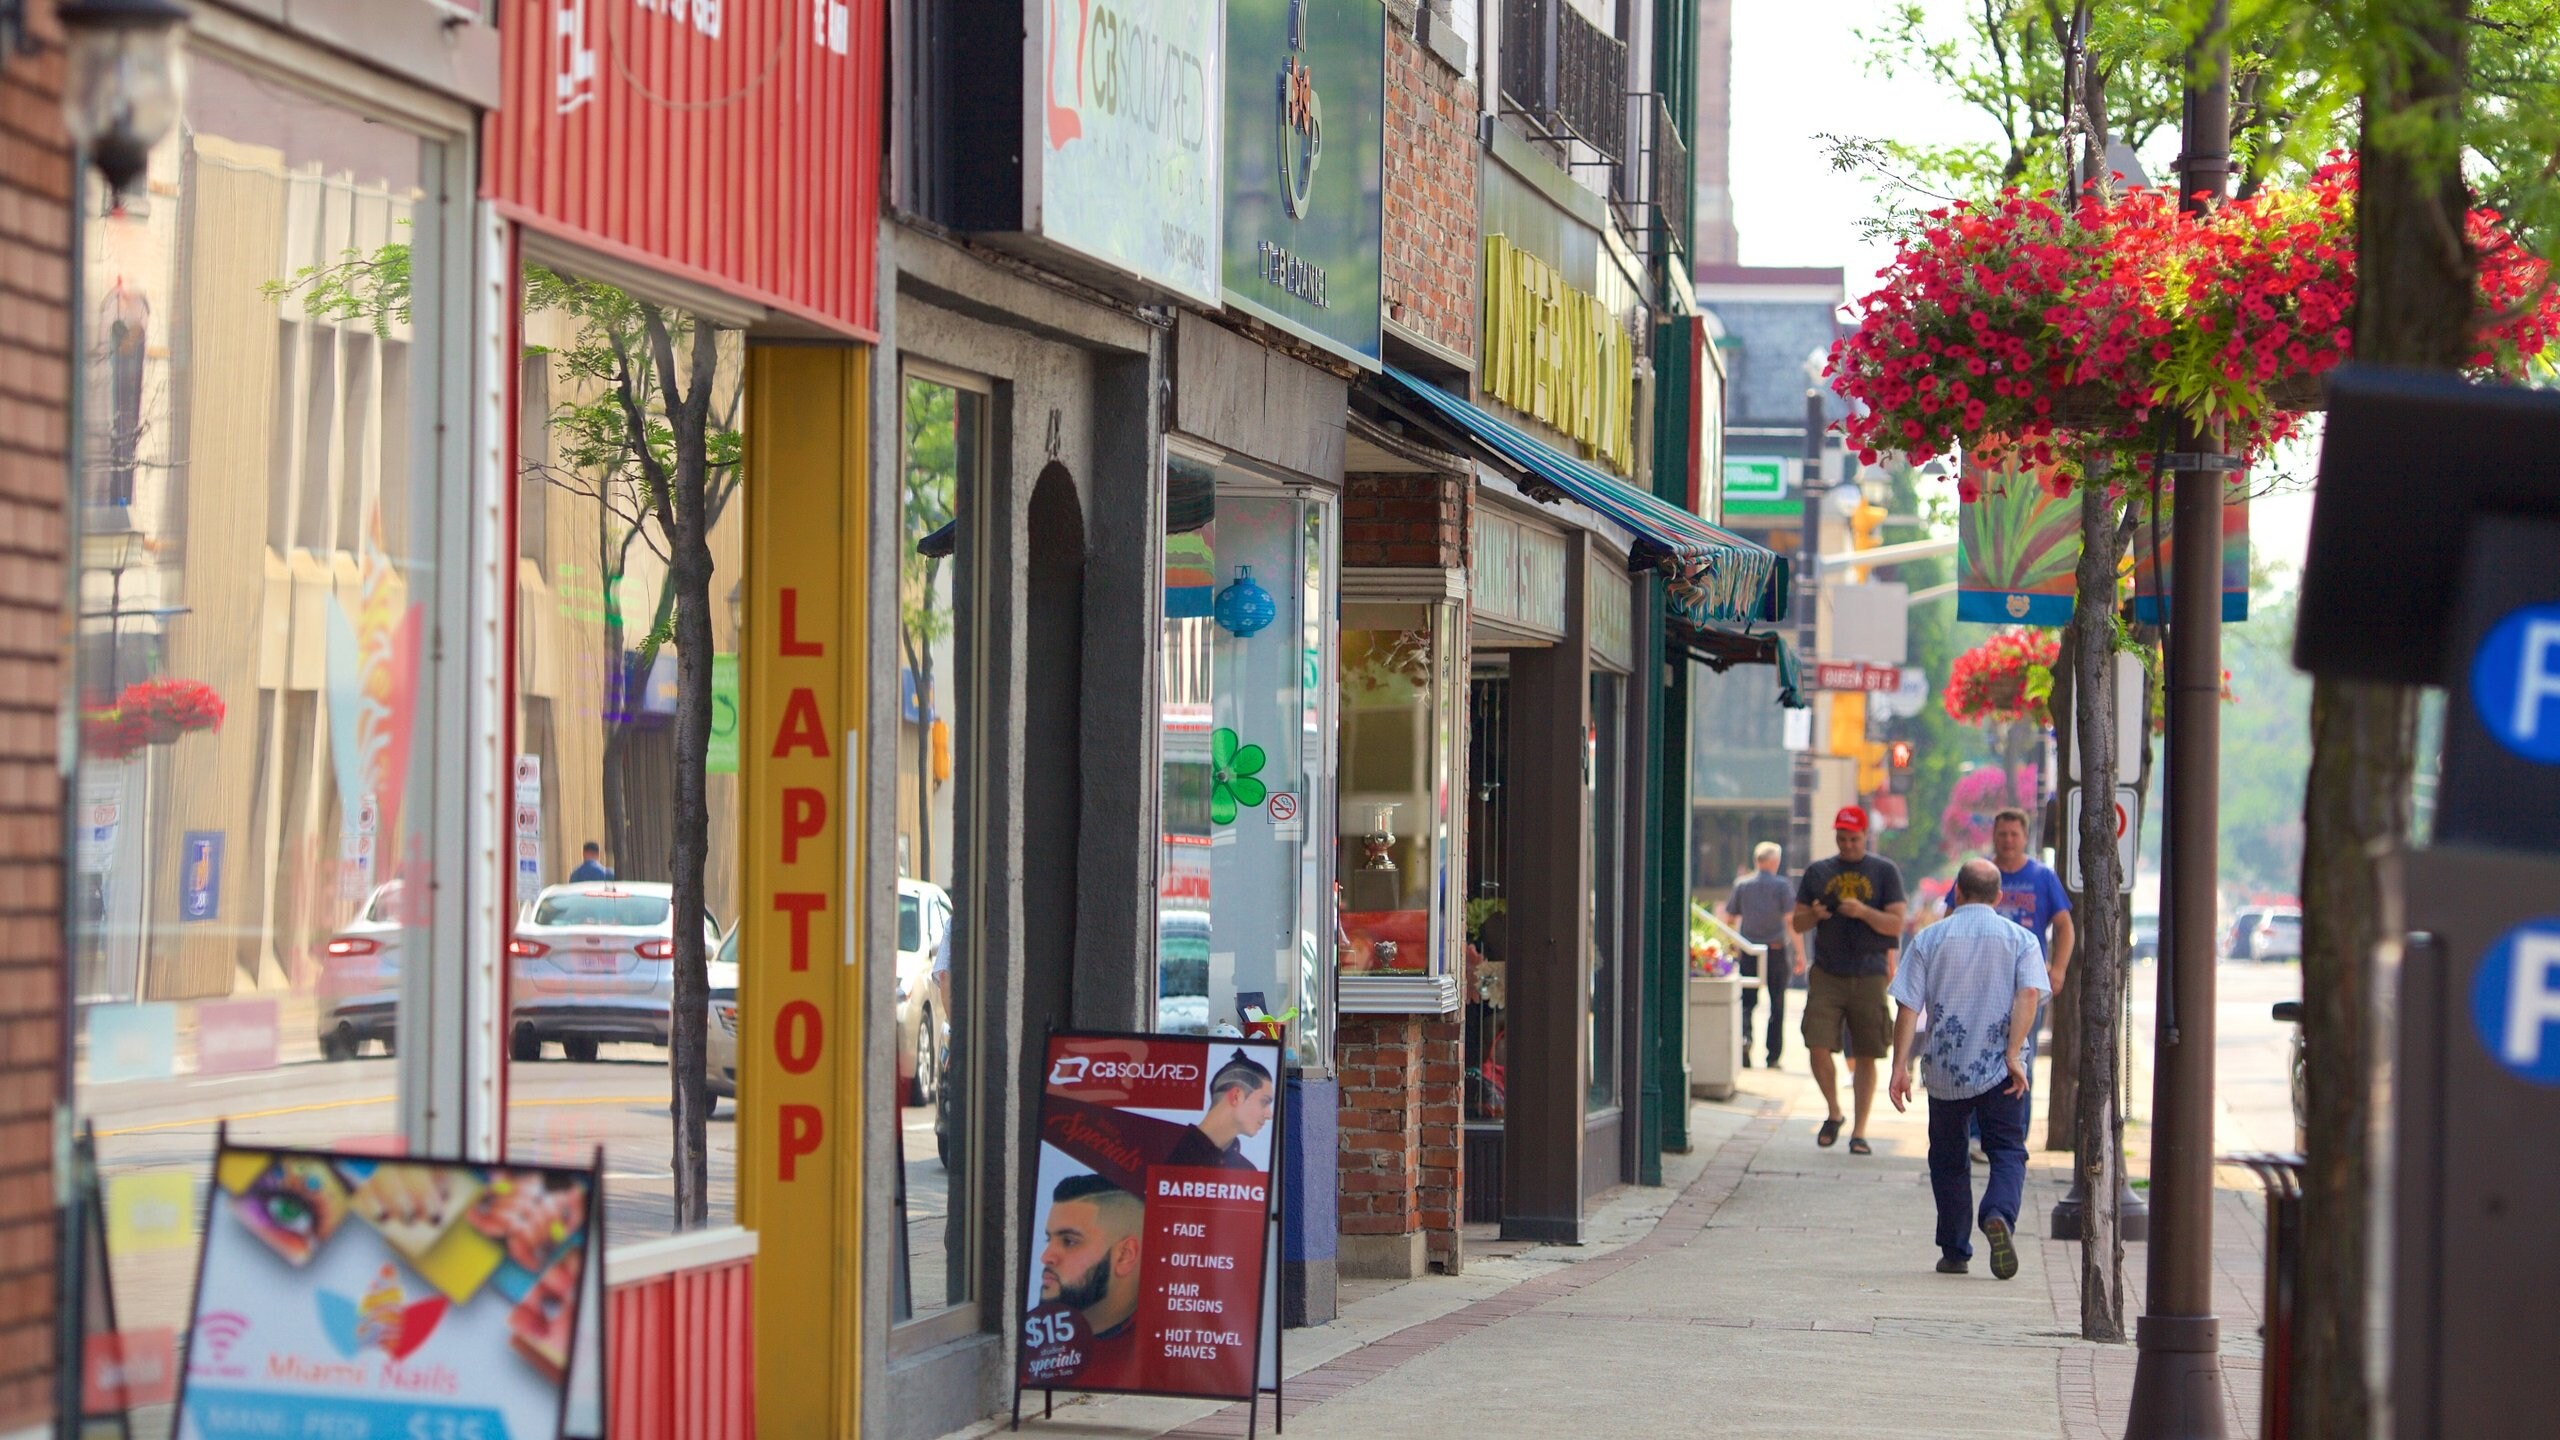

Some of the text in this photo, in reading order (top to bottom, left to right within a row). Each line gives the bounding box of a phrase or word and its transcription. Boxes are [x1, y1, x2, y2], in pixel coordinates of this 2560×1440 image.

[1146, 153, 1205, 205] STUDIO
[771, 588, 831, 1182] LAPTOP
[1158, 1180, 1265, 1202] BARBERING
[1172, 1223, 1206, 1237] FADE
[1170, 1253, 1234, 1270] OUTLINES
[1168, 1283, 1200, 1297] HAIR
[1167, 1298, 1223, 1314] DESIGNS
[1025, 1311, 1075, 1349] $15
[1164, 1329, 1242, 1346] HOT TOWEL
[1164, 1345, 1217, 1360] SHAVES
[1028, 1349, 1081, 1376] specials
[379, 1355, 459, 1394] Nails
